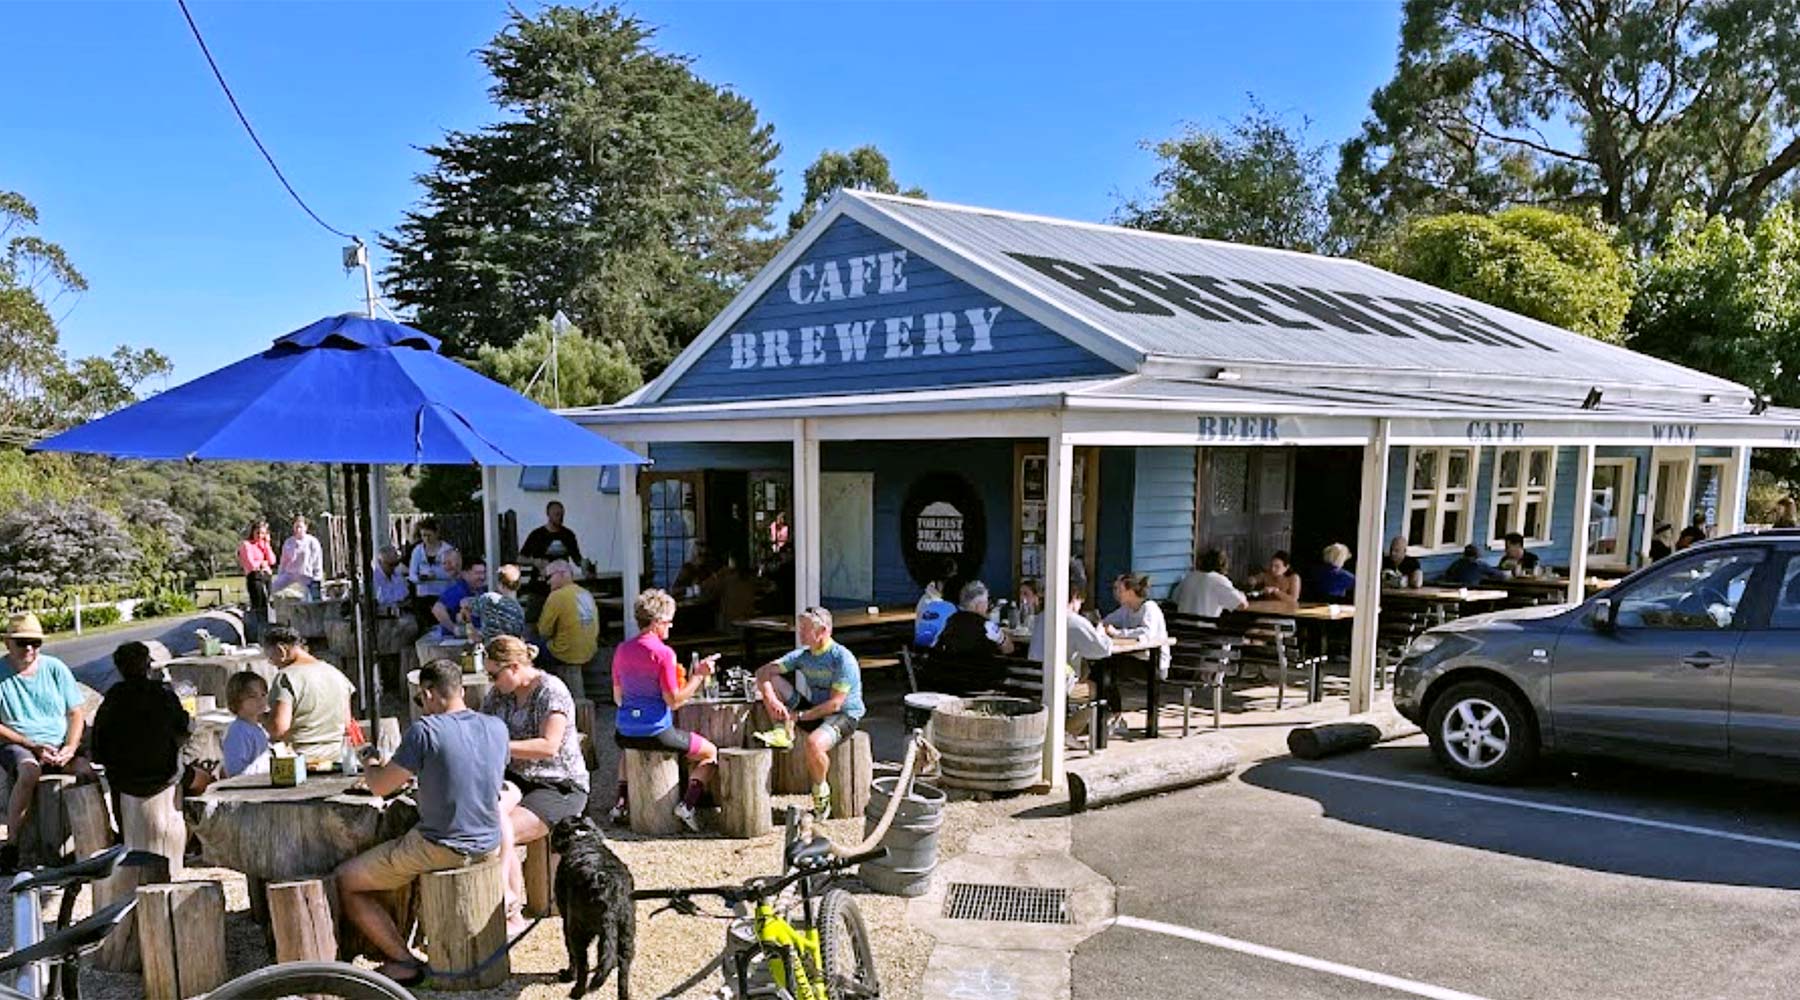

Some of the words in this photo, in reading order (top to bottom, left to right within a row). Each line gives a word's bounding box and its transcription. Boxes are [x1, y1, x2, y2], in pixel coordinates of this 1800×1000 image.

[787, 250, 908, 304] CAFE
[1000, 251, 1561, 353] BREWERY
[730, 306, 1003, 369] BREWERY
[1197, 415, 1279, 442] BEER
[1465, 420, 1525, 442] CAFE
[1652, 424, 1698, 443] WINE
[916, 540, 964, 553] COMPANY
